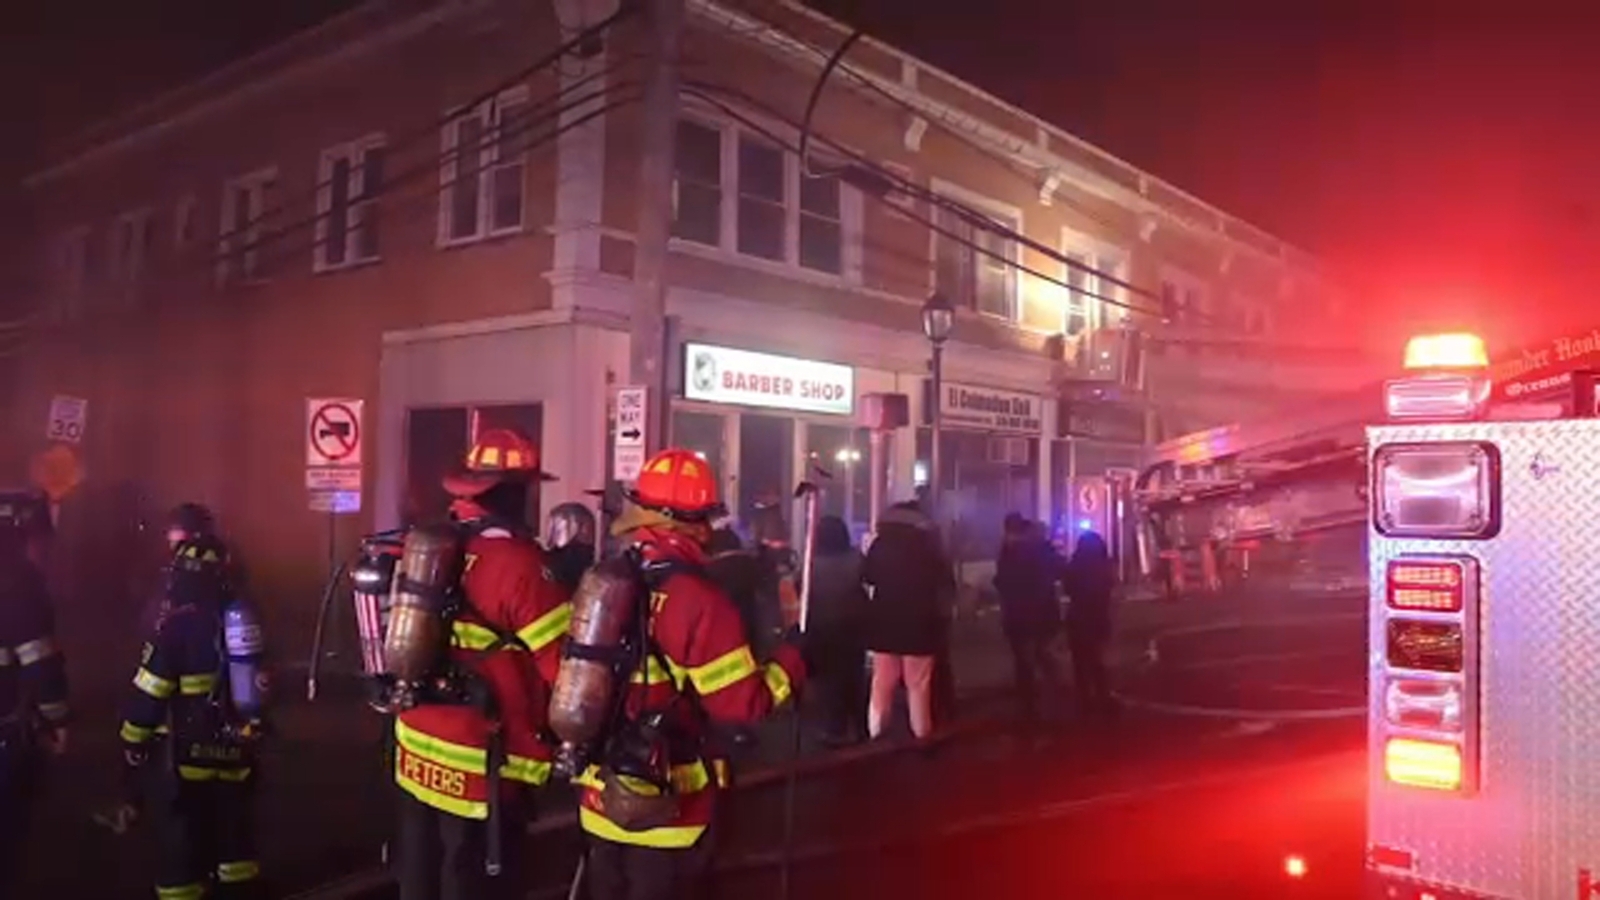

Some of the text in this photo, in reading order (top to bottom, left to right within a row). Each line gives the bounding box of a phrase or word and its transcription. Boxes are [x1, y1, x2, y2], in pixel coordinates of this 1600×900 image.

[722, 370, 845, 401] BARBER SHOP
[621, 392, 641, 408] ONE
[621, 411, 640, 424] WAY
[51, 419, 80, 438] 30
[404, 753, 466, 796] PETERS
